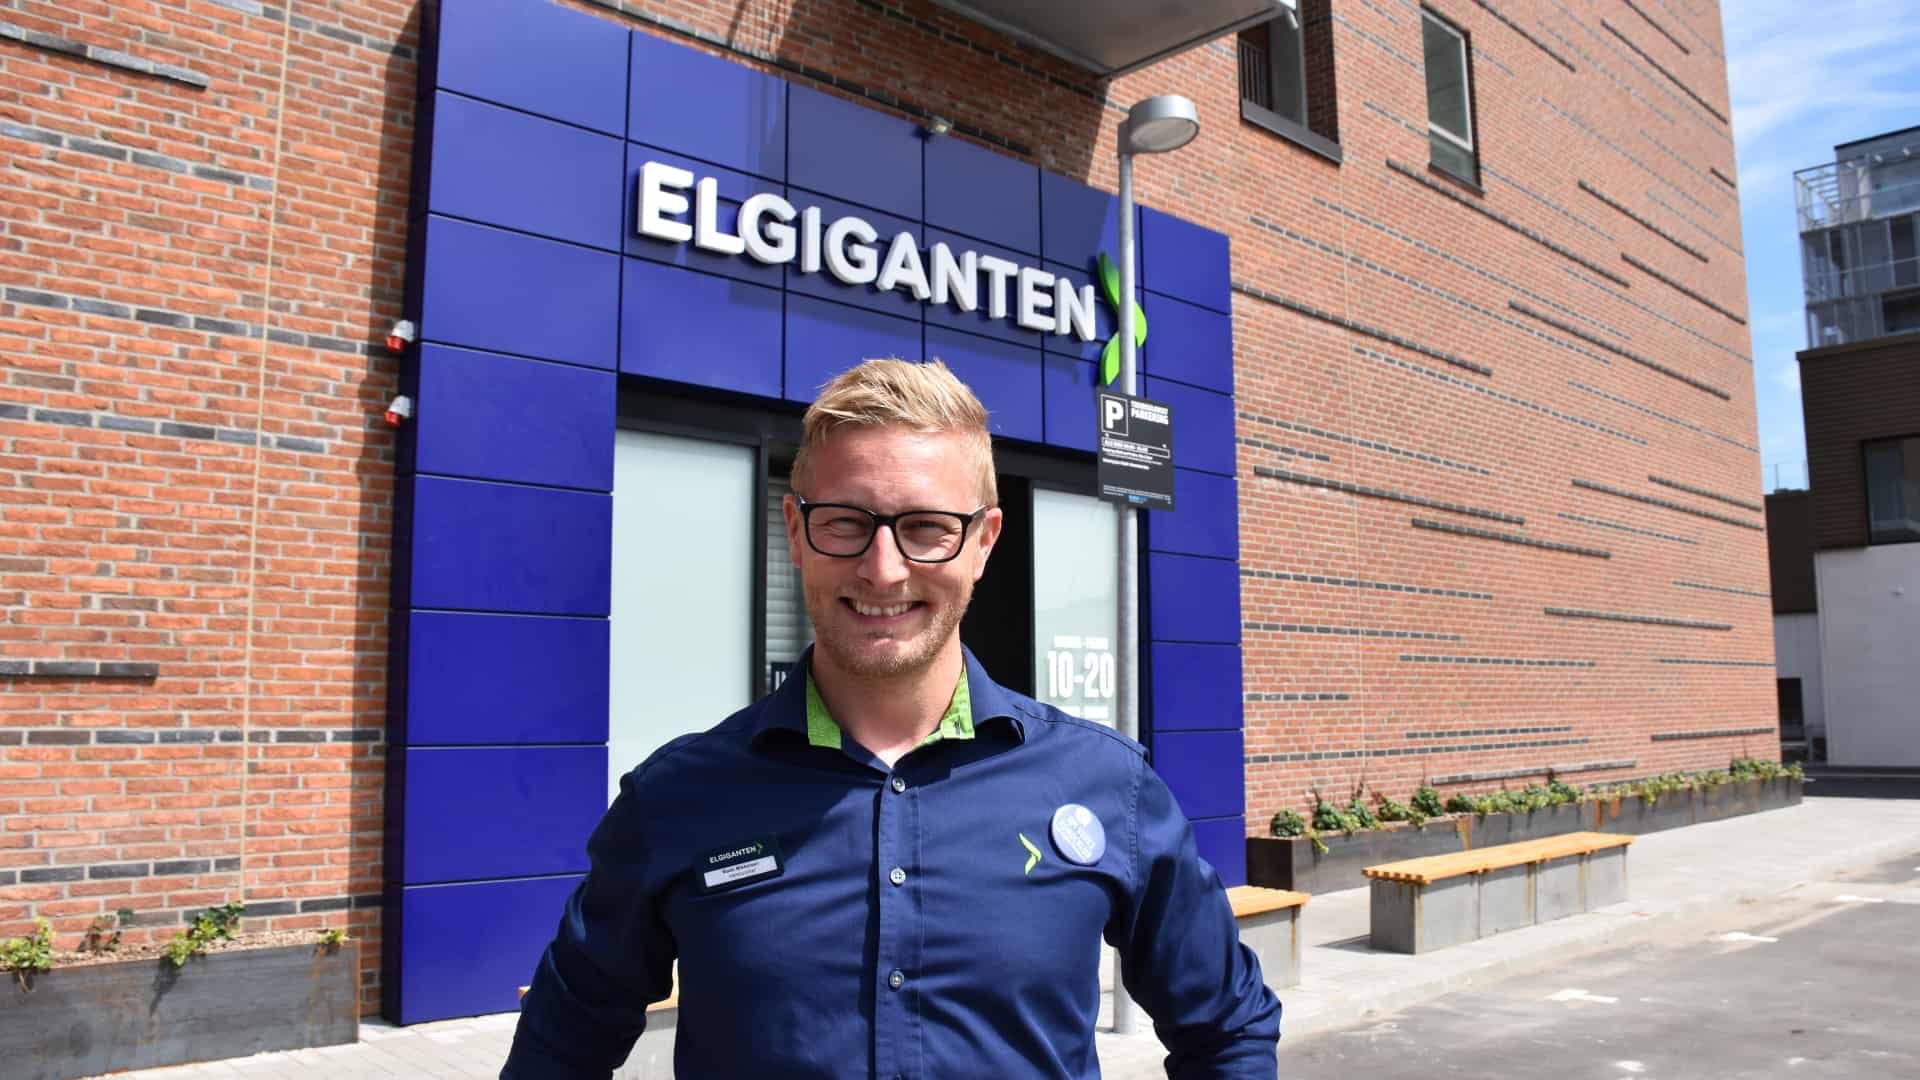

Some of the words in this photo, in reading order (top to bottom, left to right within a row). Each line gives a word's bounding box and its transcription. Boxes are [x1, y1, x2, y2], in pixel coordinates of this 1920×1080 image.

[638, 161, 1096, 341] ELGIGANTEN
[1105, 399, 1124, 429] P
[1047, 650, 1115, 698] 10-20
[709, 845, 757, 864] ELGIGANTEN
